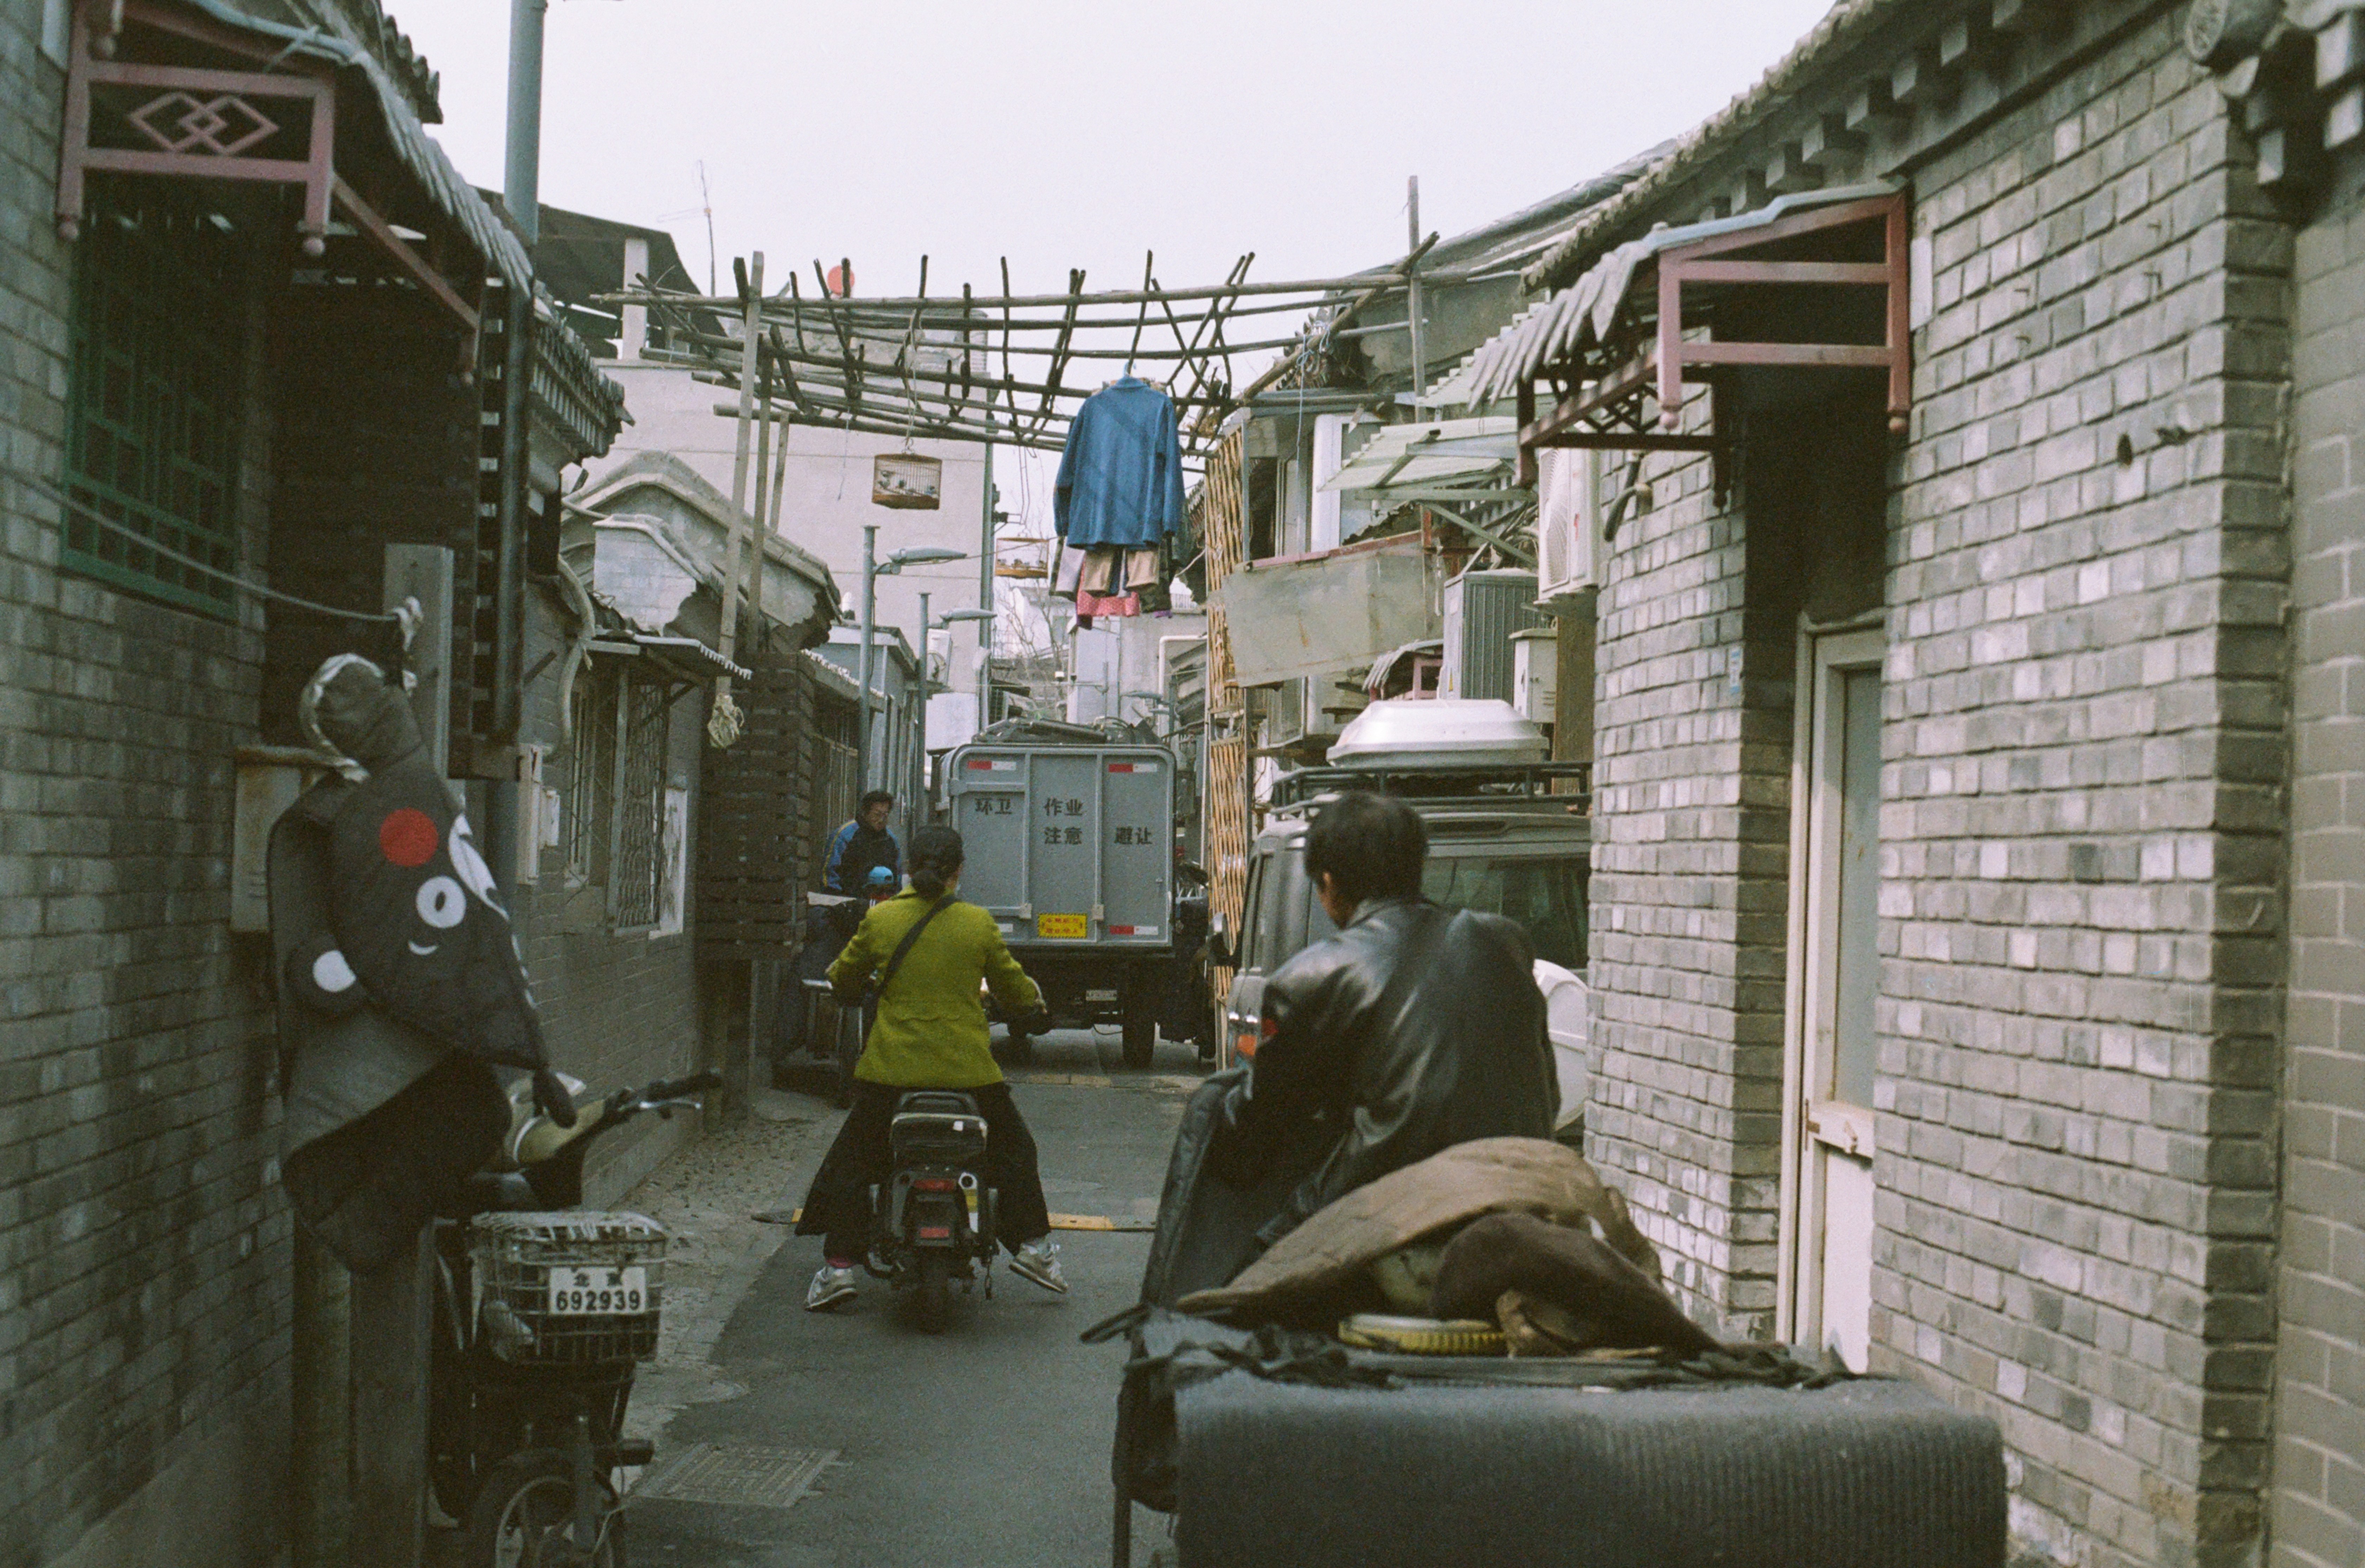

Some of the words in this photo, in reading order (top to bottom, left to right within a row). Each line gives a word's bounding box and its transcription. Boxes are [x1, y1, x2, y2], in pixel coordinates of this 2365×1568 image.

[974, 798, 1012, 815] 环卫
[1044, 798, 1084, 816] 作业
[1044, 827, 1083, 844] 注意
[1114, 826, 1152, 844] 避让
[556, 1290, 640, 1311] 692939
